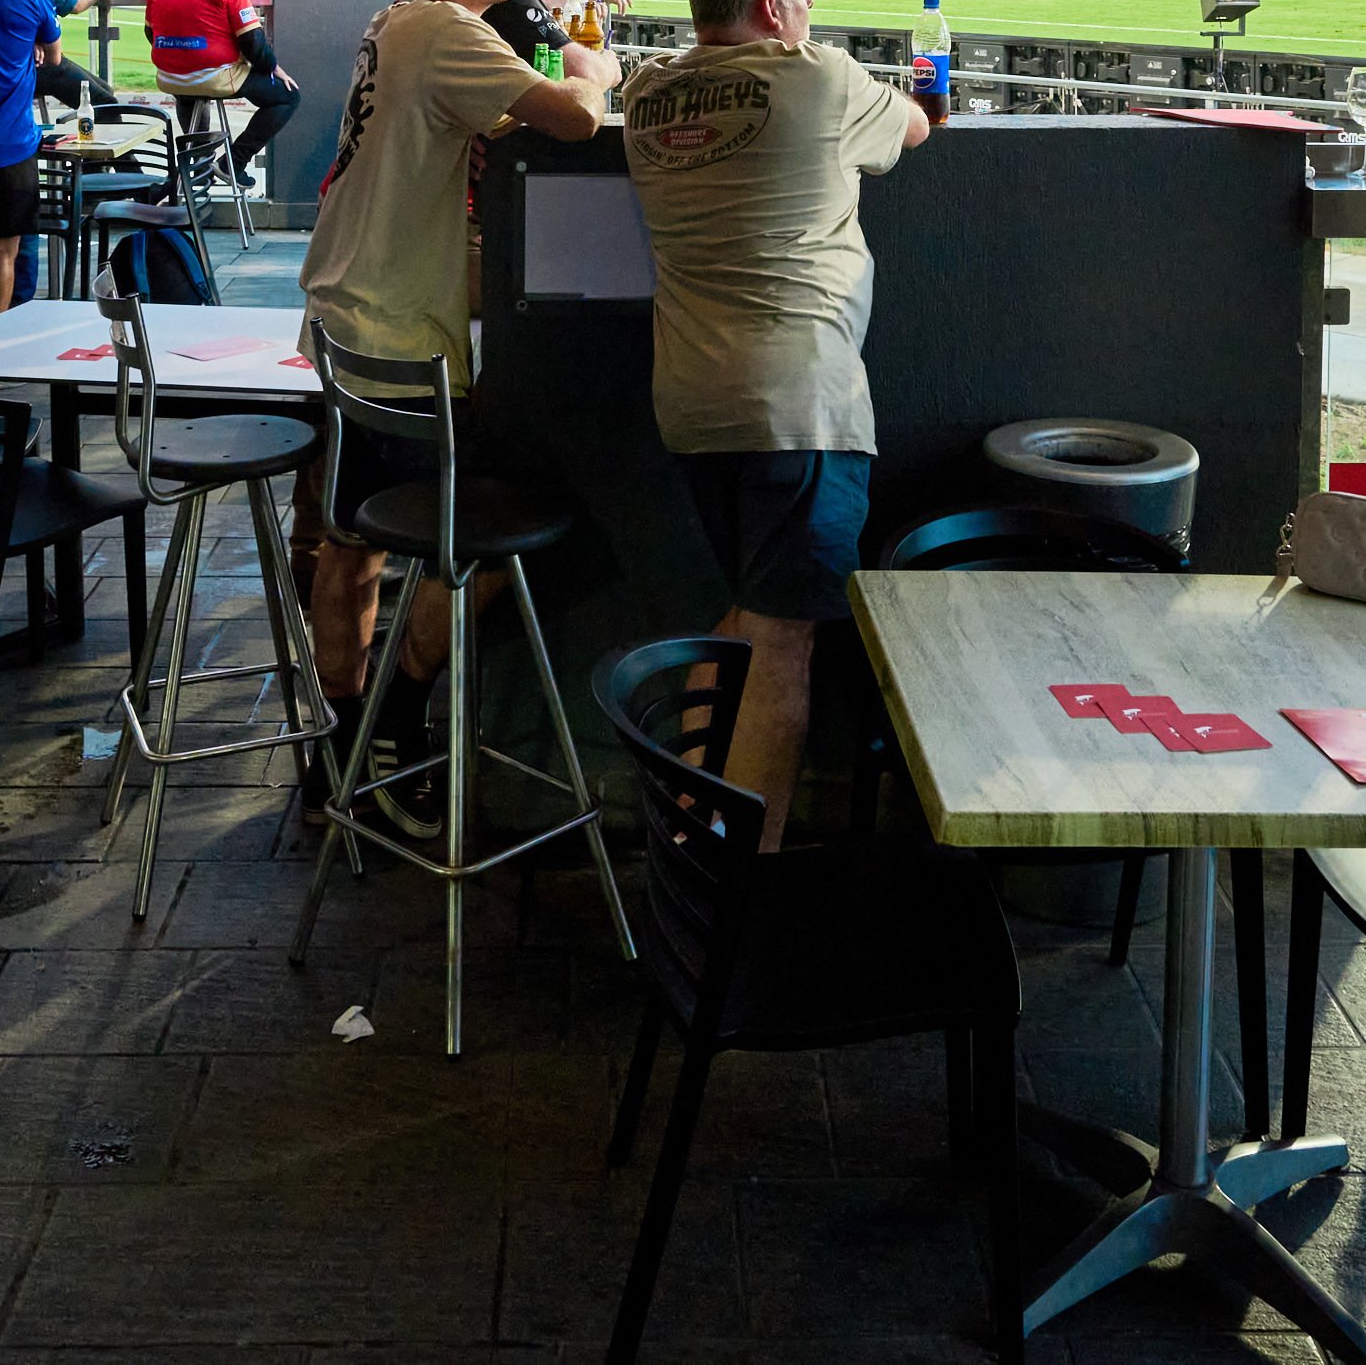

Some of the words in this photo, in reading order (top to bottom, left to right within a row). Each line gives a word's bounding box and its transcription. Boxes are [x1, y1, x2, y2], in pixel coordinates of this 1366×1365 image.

[913, 68, 935, 77] PEPSI
[629, 95, 676, 130] MAD
[682, 80, 770, 122] HUEYS
[669, 128, 707, 138] OFFSHORE
[670, 138, 704, 146] DIVISION
[710, 122, 755, 161] BOTTOM
